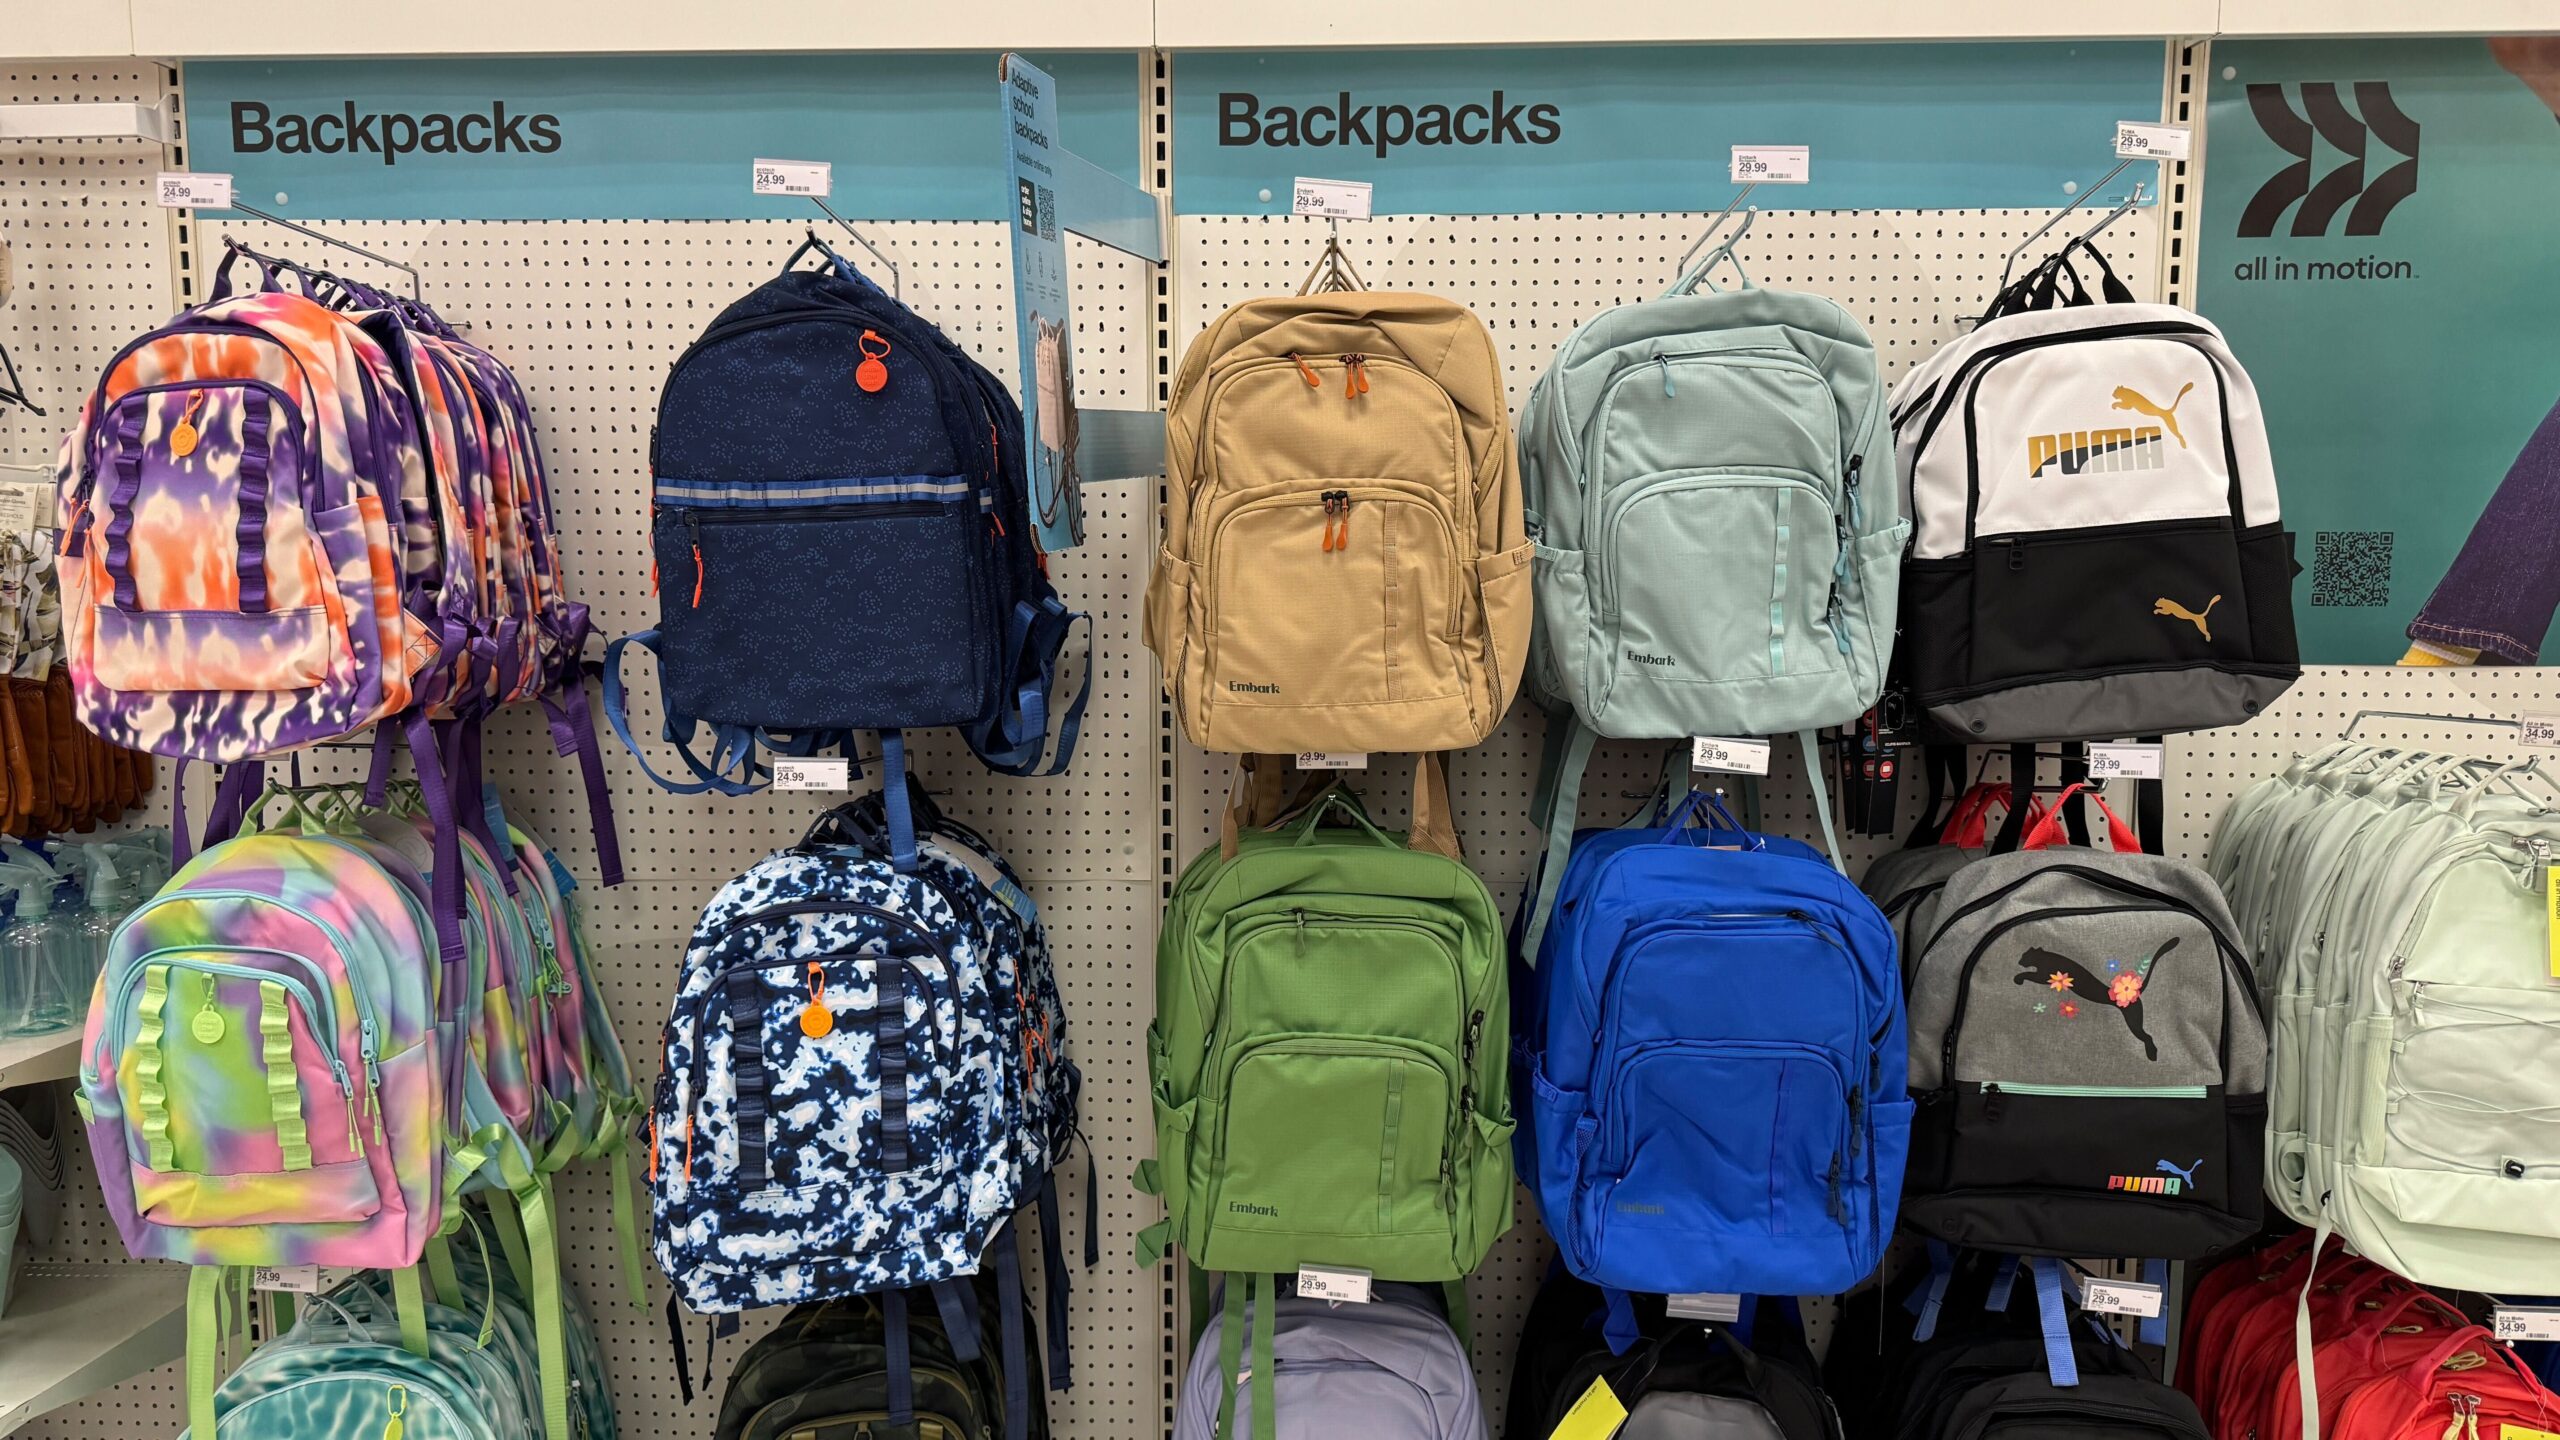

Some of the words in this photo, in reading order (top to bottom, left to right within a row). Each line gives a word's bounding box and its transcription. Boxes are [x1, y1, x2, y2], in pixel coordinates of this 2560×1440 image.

[1011, 67, 1038, 100] Adaptive
[1012, 96, 1034, 120] school
[1218, 90, 1561, 158] Backpacks
[230, 100, 562, 166] Backpacks
[1014, 116, 1048, 150] backpacks
[2120, 136, 2148, 148] 29.99
[1738, 162, 1767, 172] 29.99
[756, 174, 785, 184] 24.99
[163, 187, 191, 197] 24.99
[1296, 195, 1324, 206] 29.99
[2234, 256, 2267, 280] all
[2275, 256, 2298, 280] in
[2307, 254, 2412, 280] motion
[2028, 426, 2164, 478] PUMA
[1627, 650, 1676, 666] Embark
[1230, 680, 1280, 694] Embark
[2525, 728, 2554, 738] 34.99
[1300, 752, 1326, 760] 29.99
[1700, 748, 1728, 760] 29.99
[2093, 760, 2120, 769] 29.99
[776, 772, 804, 782] 24.99
[2108, 1175, 2181, 1195] PUMA
[1230, 1201, 1278, 1217] Embark
[256, 1272, 280, 1282] 24.99
[1301, 1280, 1327, 1290] 29.99
[2092, 1294, 2120, 1306] 29.99
[2499, 1322, 2526, 1332] 34.99
